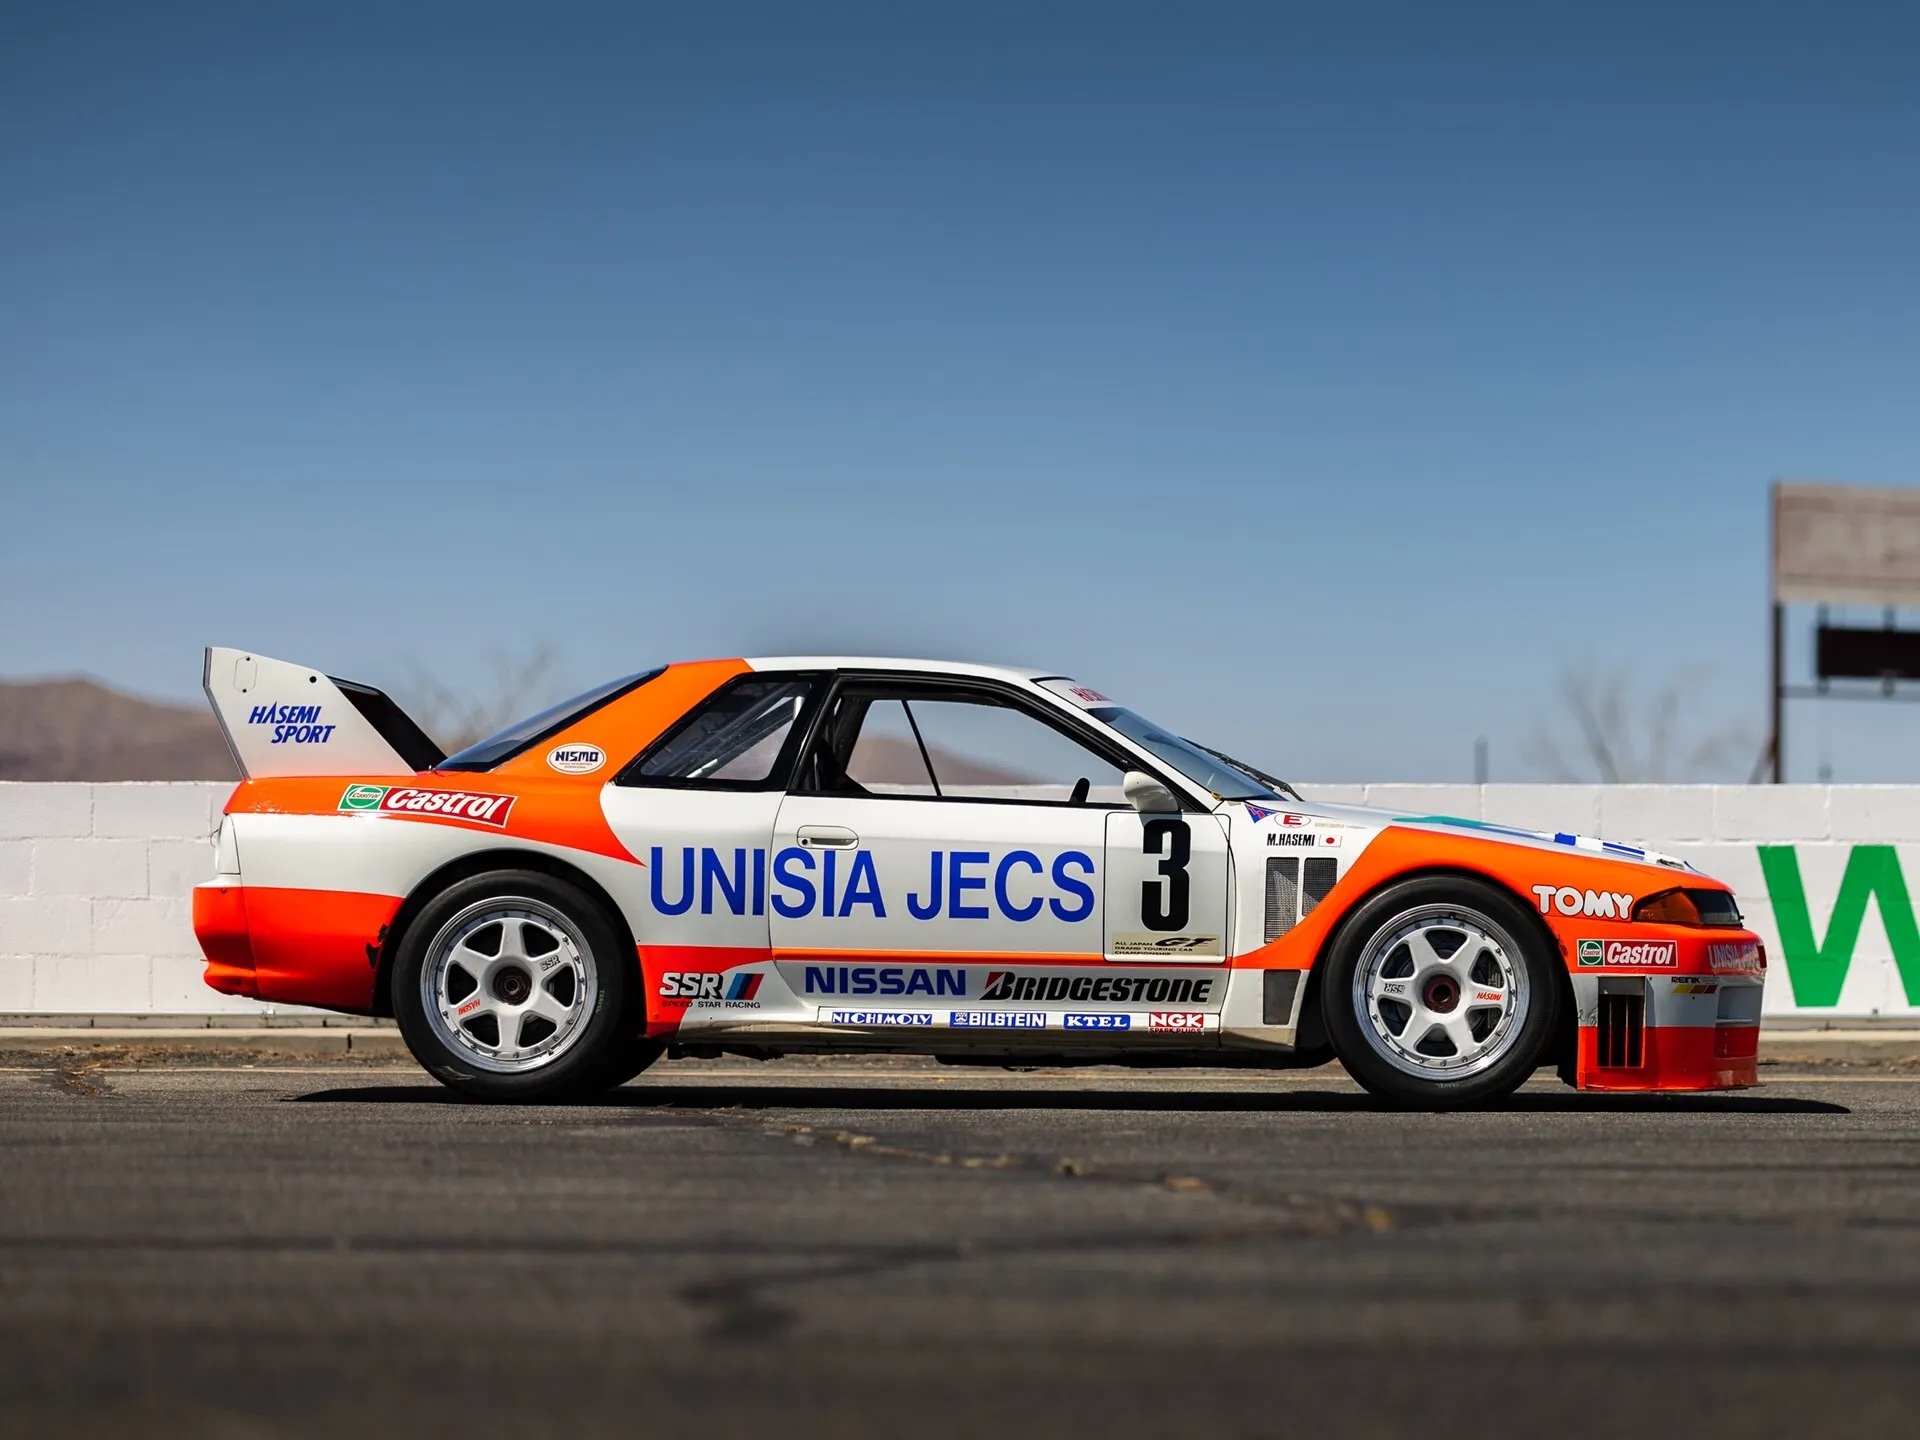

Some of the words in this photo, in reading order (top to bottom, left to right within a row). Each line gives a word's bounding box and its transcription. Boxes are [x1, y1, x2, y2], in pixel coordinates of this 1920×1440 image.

[248, 701, 322, 724] HASEMI
[271, 725, 336, 743] SPORT
[555, 751, 599, 762] NISMO
[387, 789, 508, 820] Castrol
[1267, 833, 1315, 846] M.HASEMI
[1141, 819, 1191, 932] 3
[650, 846, 887, 919] UNISIA
[907, 850, 1095, 923] JECS
[1532, 885, 1634, 920] TOMY
[1607, 942, 1674, 964] Castrol
[540, 954, 561, 971] SSR
[659, 971, 722, 998] SSR
[805, 967, 966, 996] NISSAN
[979, 971, 1213, 1003] BRIDGESTONE
[1384, 983, 1406, 994] SSR
[1476, 991, 1502, 1001] HASEMI
[458, 999, 480, 1015] HASEMI
[725, 1001, 761, 1009] RACING
[832, 1012, 932, 1025] NICHIMOLY
[969, 1013, 1044, 1027] BILSTEIN
[1067, 1016, 1128, 1027] KTEL
[1151, 1013, 1203, 1027] NGK
